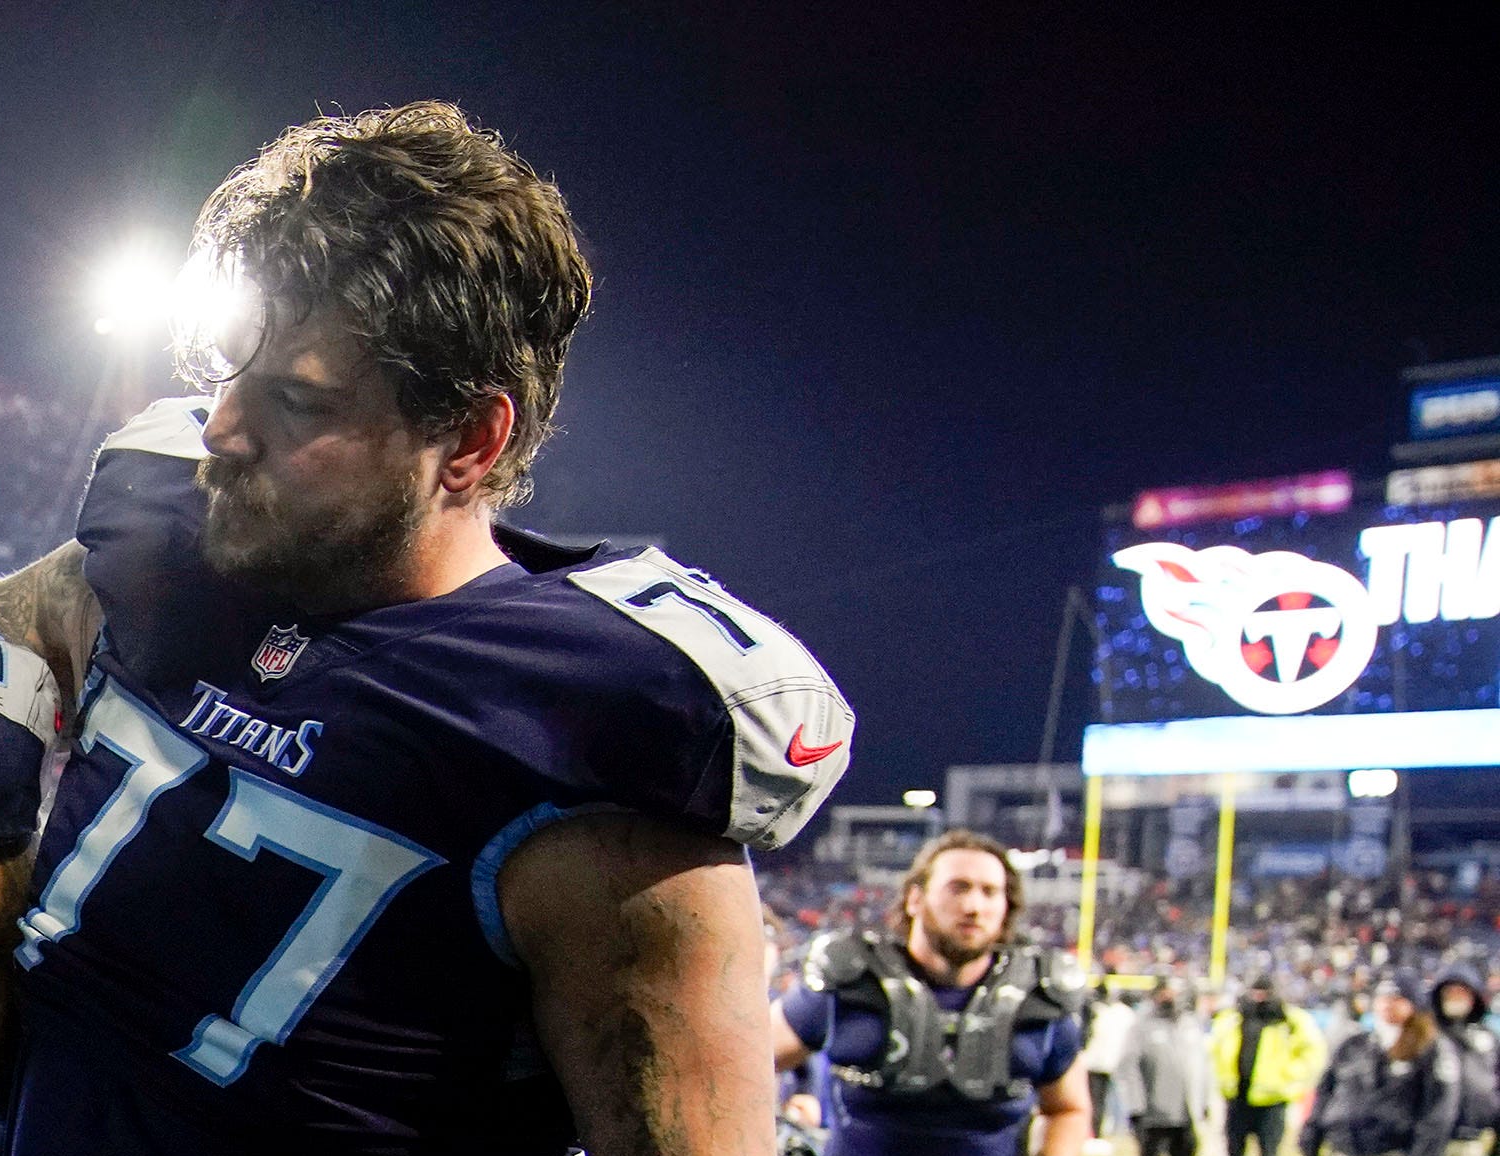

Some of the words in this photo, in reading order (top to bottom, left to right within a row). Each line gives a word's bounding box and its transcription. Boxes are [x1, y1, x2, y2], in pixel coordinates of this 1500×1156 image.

[257, 644, 290, 671] NFL
[613, 567, 764, 656] 7
[178, 679, 324, 778] TITANS
[13, 673, 449, 1087] 77
